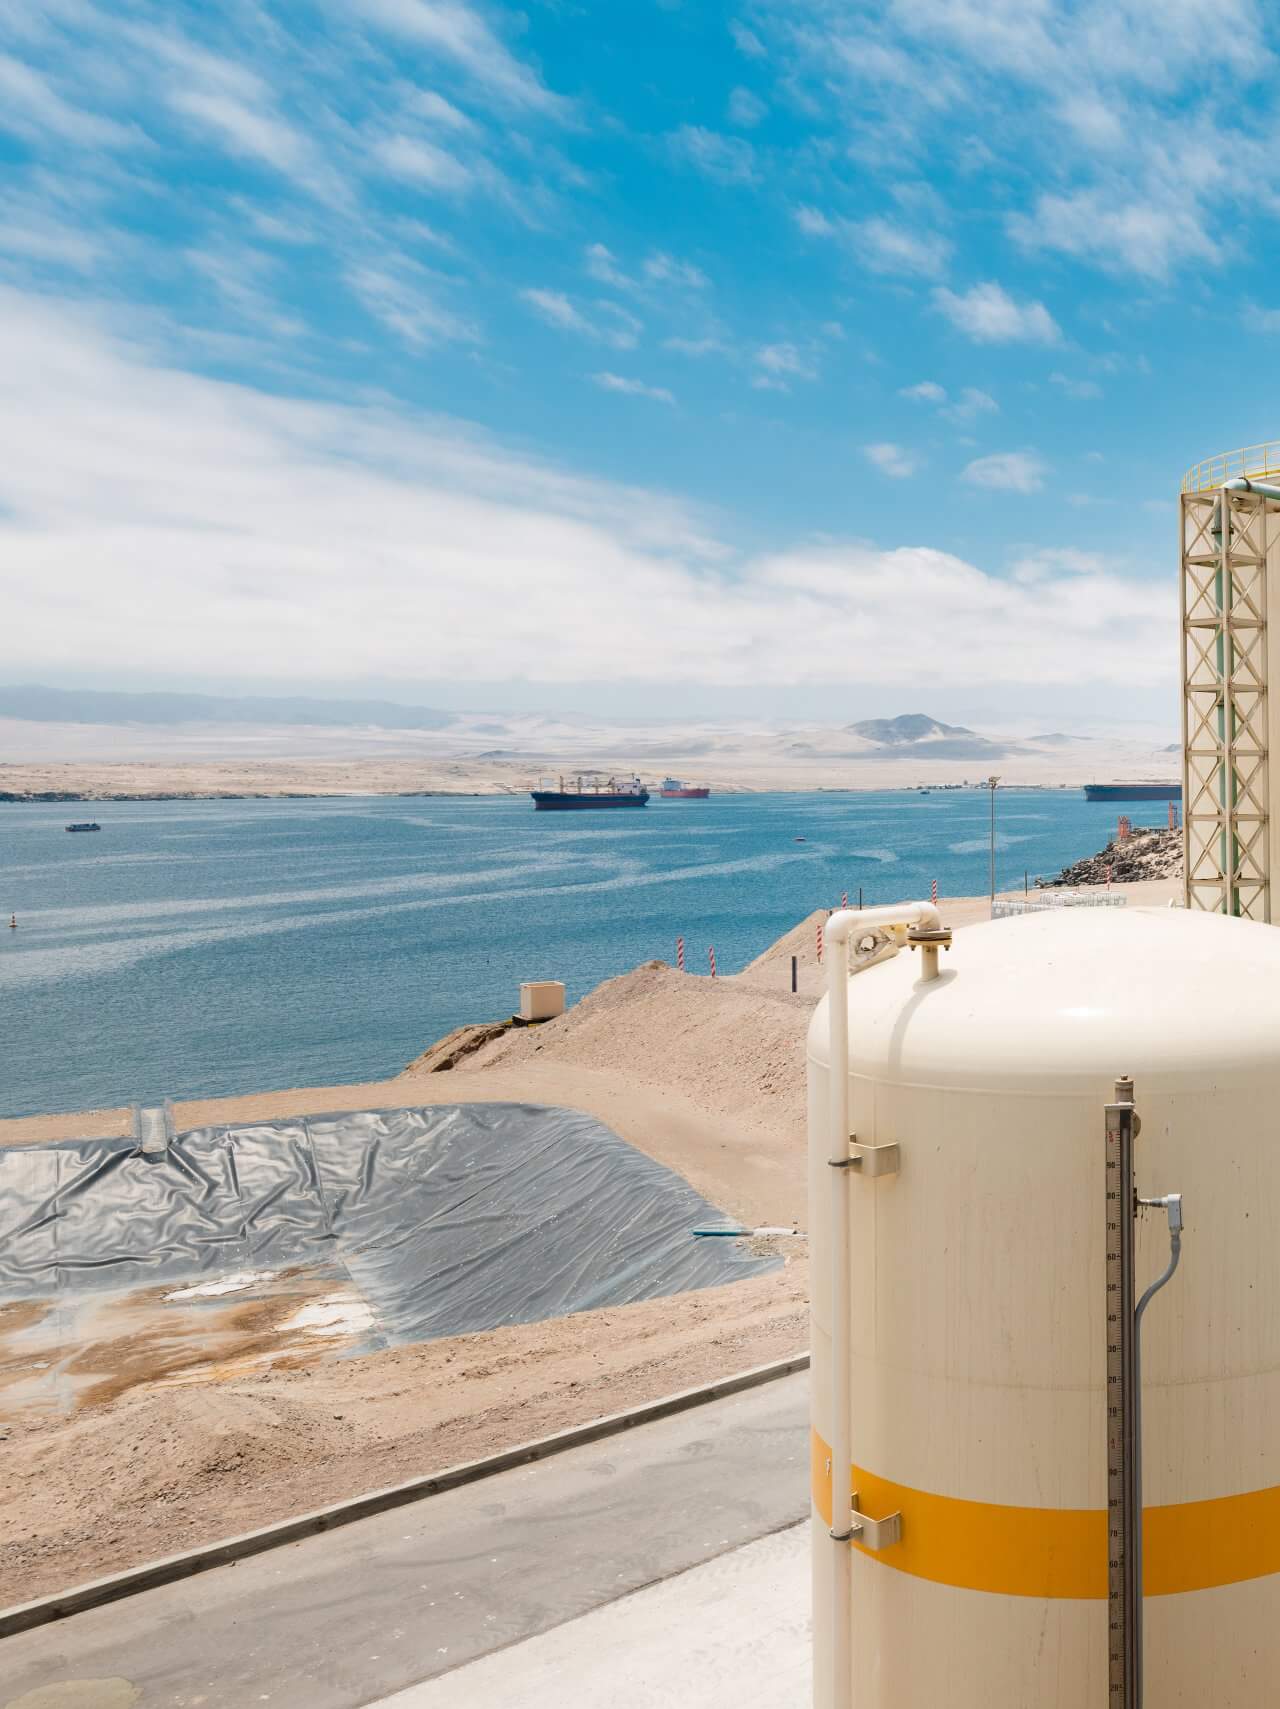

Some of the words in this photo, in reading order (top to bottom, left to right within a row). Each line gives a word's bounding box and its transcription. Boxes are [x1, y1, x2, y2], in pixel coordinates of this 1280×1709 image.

[1107, 1222, 1116, 1231] 70
[1107, 1253, 1117, 1261] 60
[1107, 1284, 1117, 1292] 50
[1108, 1314, 1117, 1322] 40
[1108, 1375, 1117, 1384] 20
[1109, 1407, 1117, 1416] 10
